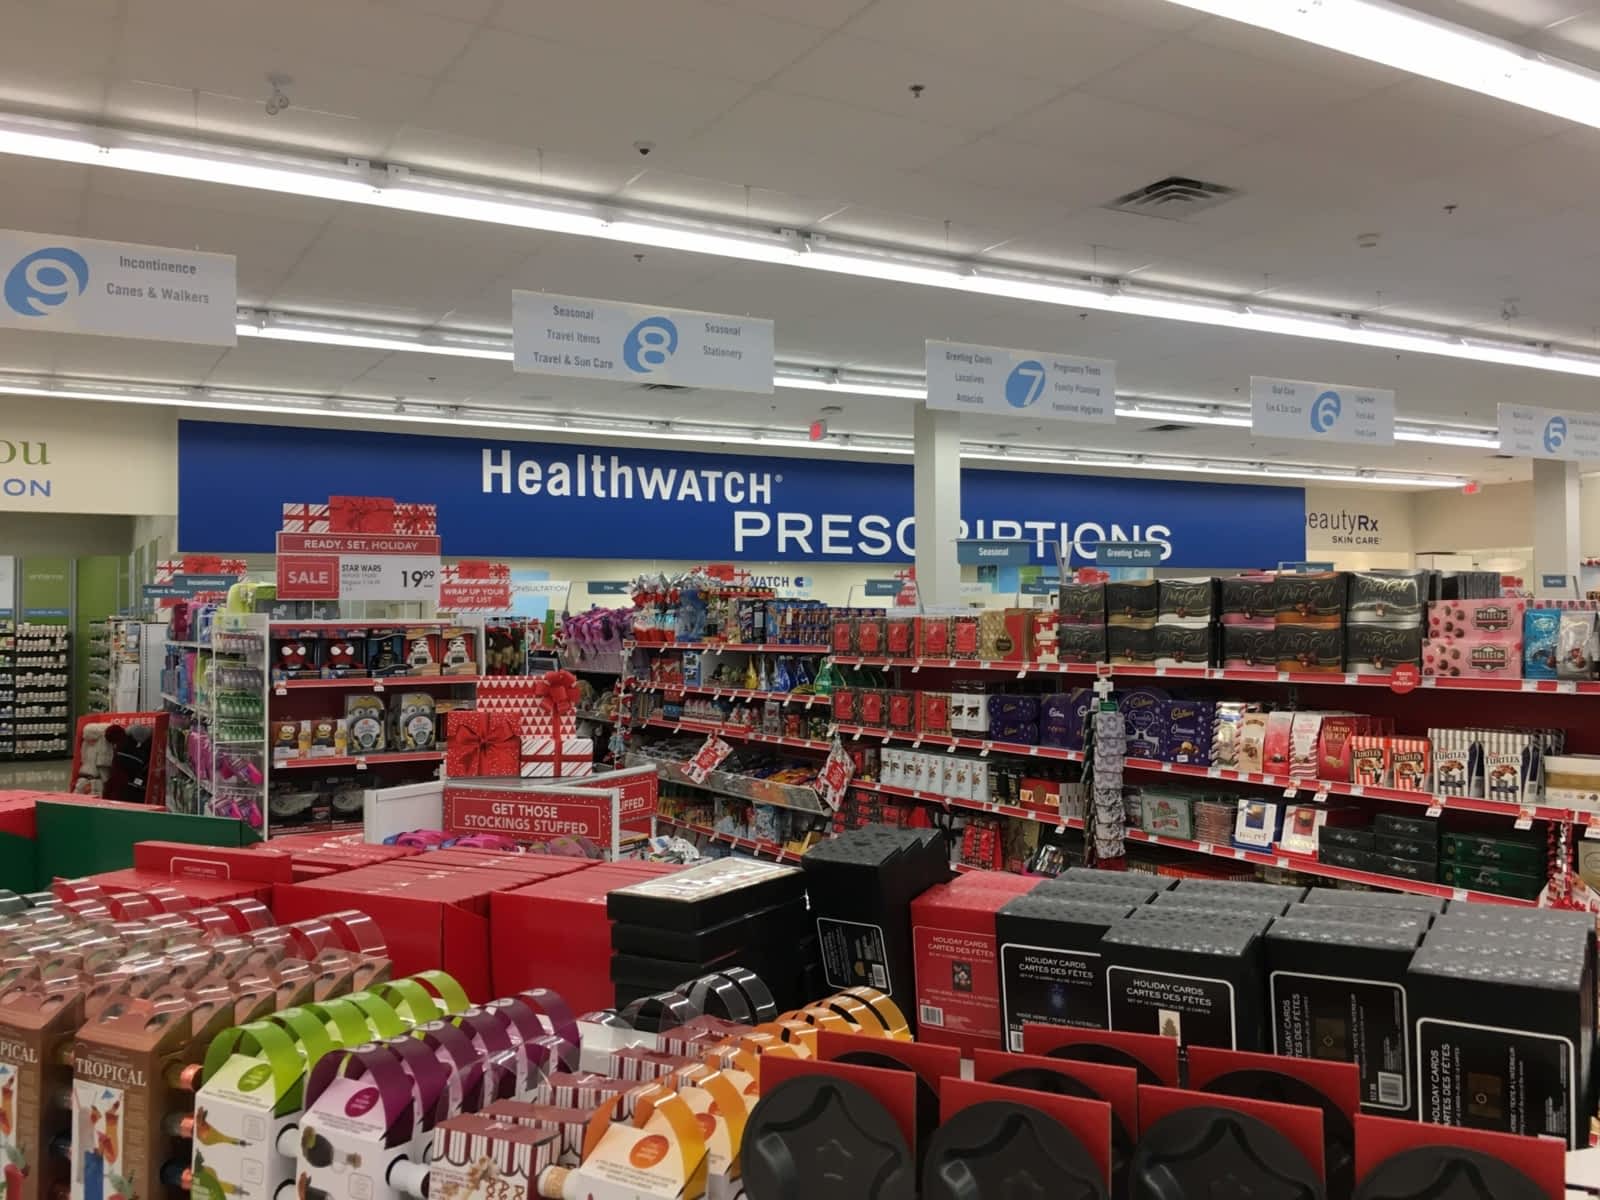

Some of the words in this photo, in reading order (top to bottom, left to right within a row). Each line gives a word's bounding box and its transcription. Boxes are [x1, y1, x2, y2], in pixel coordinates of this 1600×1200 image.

[119, 255, 197, 275] Incontinence
[10, 250, 87, 316] 9
[106, 283, 144, 298] Canes
[147, 287, 157, 299] &
[161, 287, 209, 304] Walkers
[553, 305, 594, 320] Seasonal
[546, 329, 574, 342] Travel
[577, 332, 601, 345] Items
[705, 322, 741, 337] Seasonal
[628, 319, 676, 373] 8
[703, 345, 743, 360] Stationery
[533, 352, 562, 365] Travel
[564, 355, 571, 365] &
[574, 355, 591, 368] Sun
[593, 357, 613, 369] Care
[946, 352, 973, 365] Greeting
[1010, 364, 1045, 407] 7
[1313, 393, 1340, 432] 6
[1546, 418, 1566, 453] 5
[1305, 509, 1379, 535] eautyRx
[734, 510, 1172, 561] PRESCIPTIONS
[1332, 535, 1353, 544] SKIN
[1355, 536, 1380, 545] CARE
[371, 541, 419, 550] HOLIDAY
[978, 547, 1008, 557] Seasonal
[1106, 548, 1132, 559] Greeting
[1133, 549, 1151, 558] Cards
[341, 564, 359, 572] STAR
[360, 564, 382, 573] WARS
[288, 570, 329, 585] SALE
[444, 588, 468, 596] WRAP
[469, 588, 480, 596] UP
[482, 588, 504, 596] YOUR
[512, 584, 568, 593] ONSULTATION
[1354, 750, 1382, 759] TURTLES
[1394, 752, 1421, 761] TURTLES
[1434, 752, 1467, 761] TURTLES
[1486, 756, 1520, 765] TURTLES
[491, 802, 514, 815] GET
[518, 804, 558, 818] THOSE
[464, 814, 529, 831] STOCKINGS
[534, 819, 588, 835] STUFFED
[927, 943, 955, 953] CARTES
[932, 936, 962, 945] HOLIDAY
[963, 940, 988, 949] CARDS
[1018, 963, 1049, 973] CARTES
[1050, 967, 1067, 975] DES
[1025, 956, 1058, 966] HOLIDAY
[1059, 960, 1087, 969] CARDS
[1126, 987, 1161, 999] CARTES
[1162, 992, 1181, 1002] DES
[1133, 979, 1171, 991] HOLIDAY
[1172, 985, 1204, 996] CARDS
[1283, 999, 1292, 1030] CARDS
[1294, 1022, 1302, 1041] DES
[75, 1056, 146, 1087] TROPICAL
[1430, 1049, 1440, 1083] CARDS
[1442, 1076, 1451, 1096] DES
[1431, 1083, 1441, 1124] HOLIDAY
[1442, 1097, 1452, 1126] ARTES
